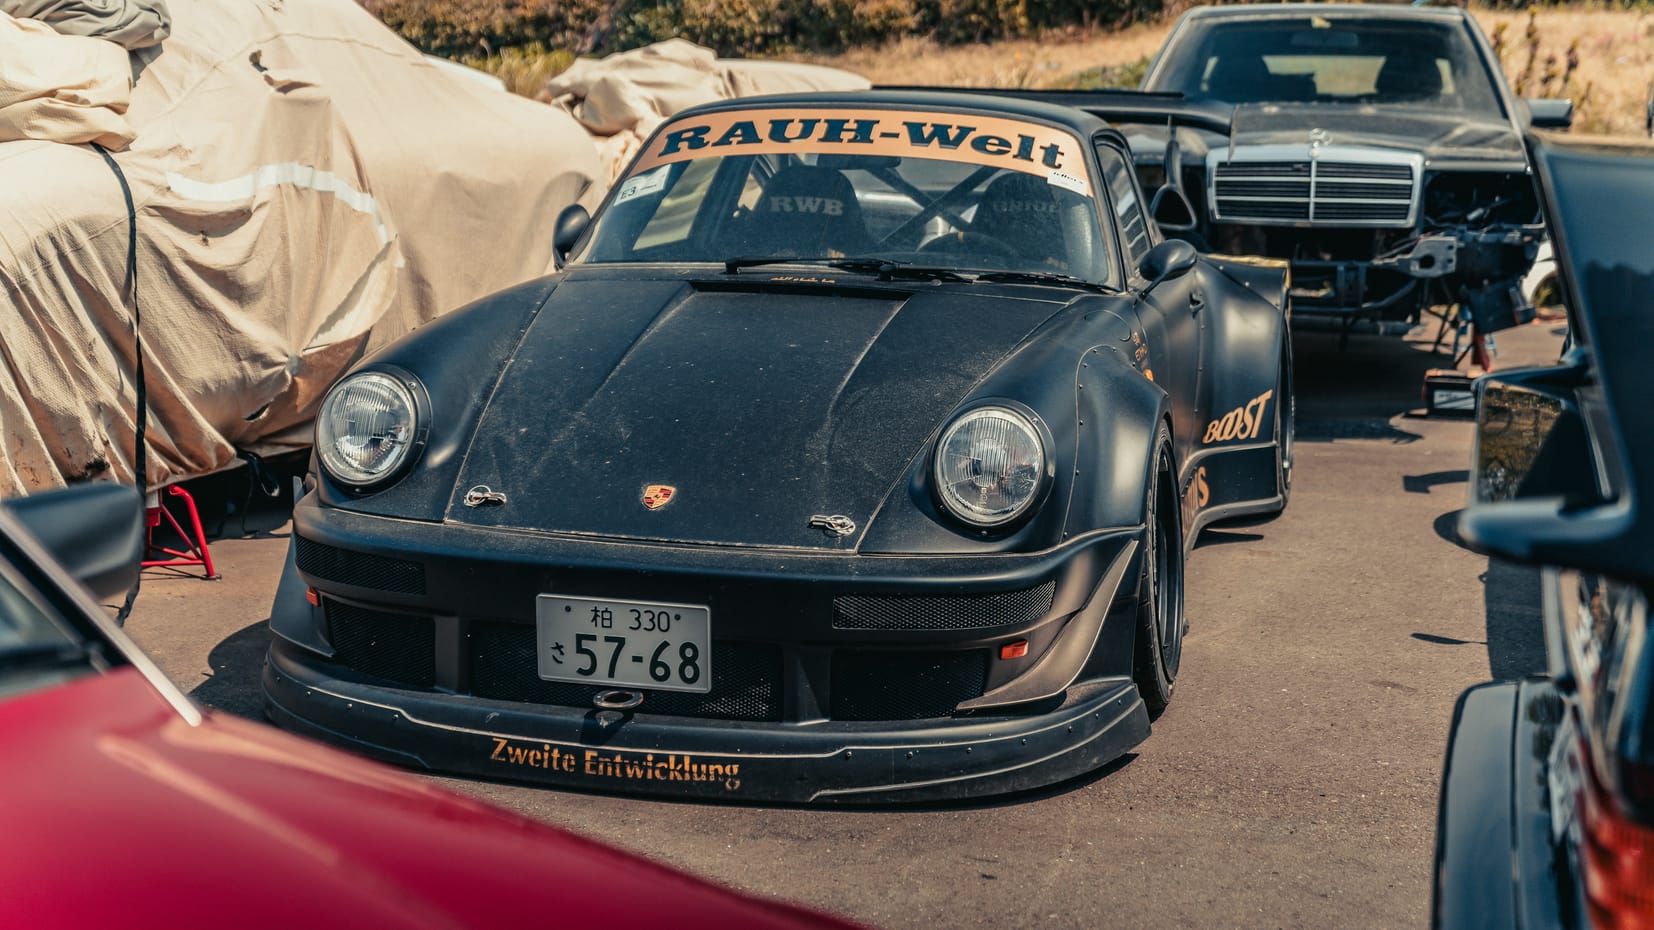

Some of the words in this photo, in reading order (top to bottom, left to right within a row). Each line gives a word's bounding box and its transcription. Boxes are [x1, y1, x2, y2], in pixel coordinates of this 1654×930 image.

[658, 118, 1065, 169] RAUH-Welt
[769, 196, 844, 217] RWB
[1202, 389, 1274, 444] BOOST
[590, 605, 613, 629] 柏
[628, 608, 671, 633] 330
[551, 641, 565, 664] さ
[575, 633, 700, 684] 57-68
[490, 737, 576, 772] Zweite
[585, 750, 741, 791] Entwicklung
